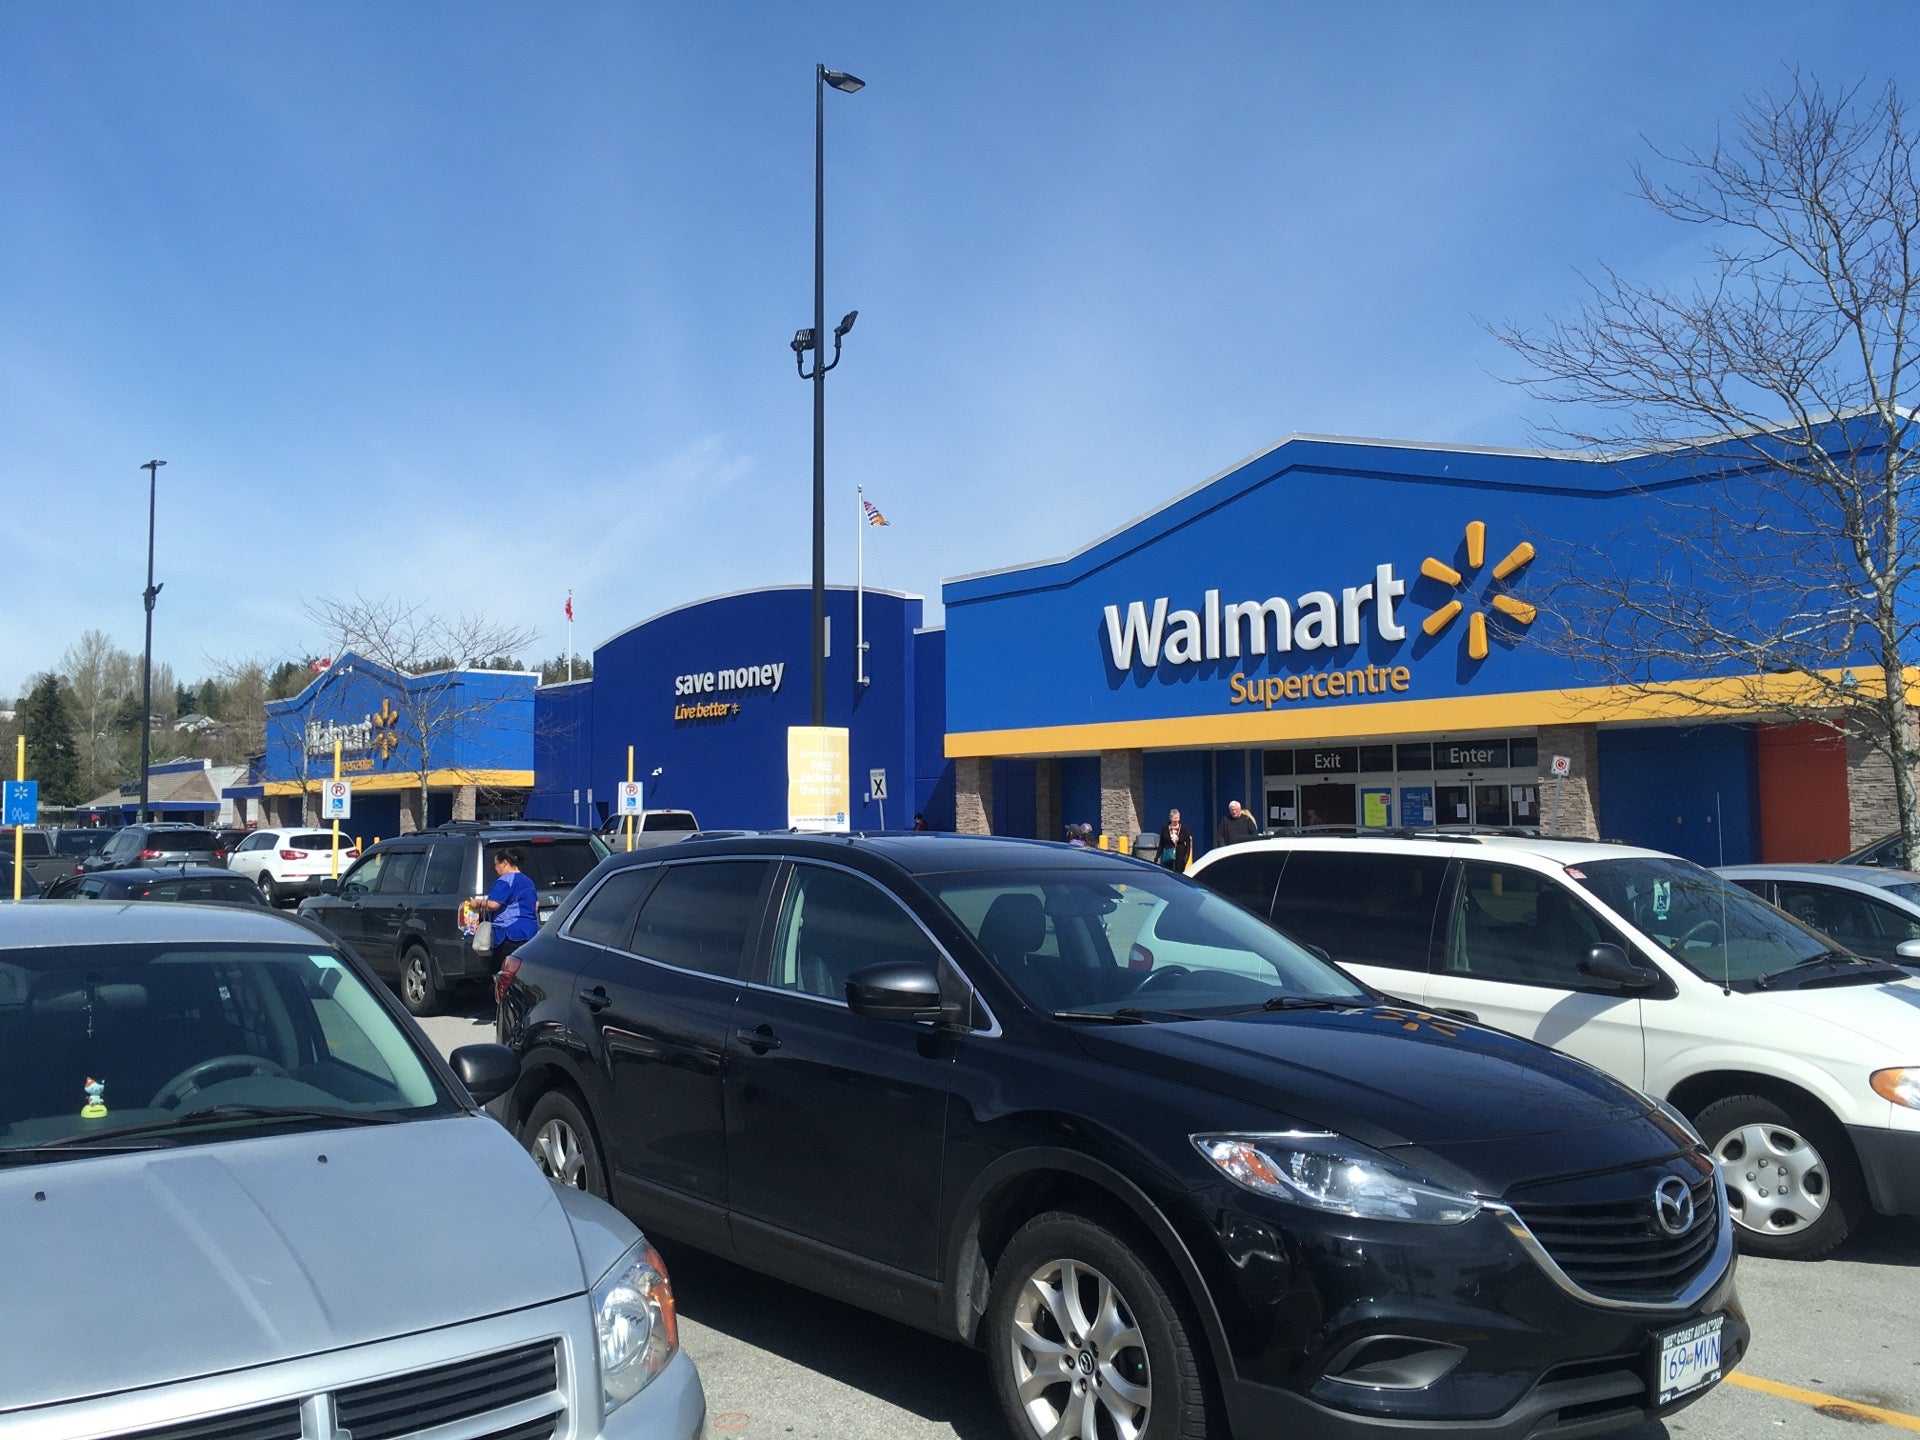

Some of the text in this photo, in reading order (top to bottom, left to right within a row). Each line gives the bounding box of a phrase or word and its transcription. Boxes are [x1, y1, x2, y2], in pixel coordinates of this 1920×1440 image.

[1104, 563, 1407, 670] Walmart
[675, 662, 785, 696] save money
[1229, 663, 1411, 710] Supercentre
[674, 702, 730, 720] Live better
[1314, 753, 1341, 769] Exit
[1450, 747, 1494, 764] Enter
[873, 778, 884, 796] X
[1677, 1327, 1694, 1345] COAST
[1694, 1322, 1707, 1338] AUTO
